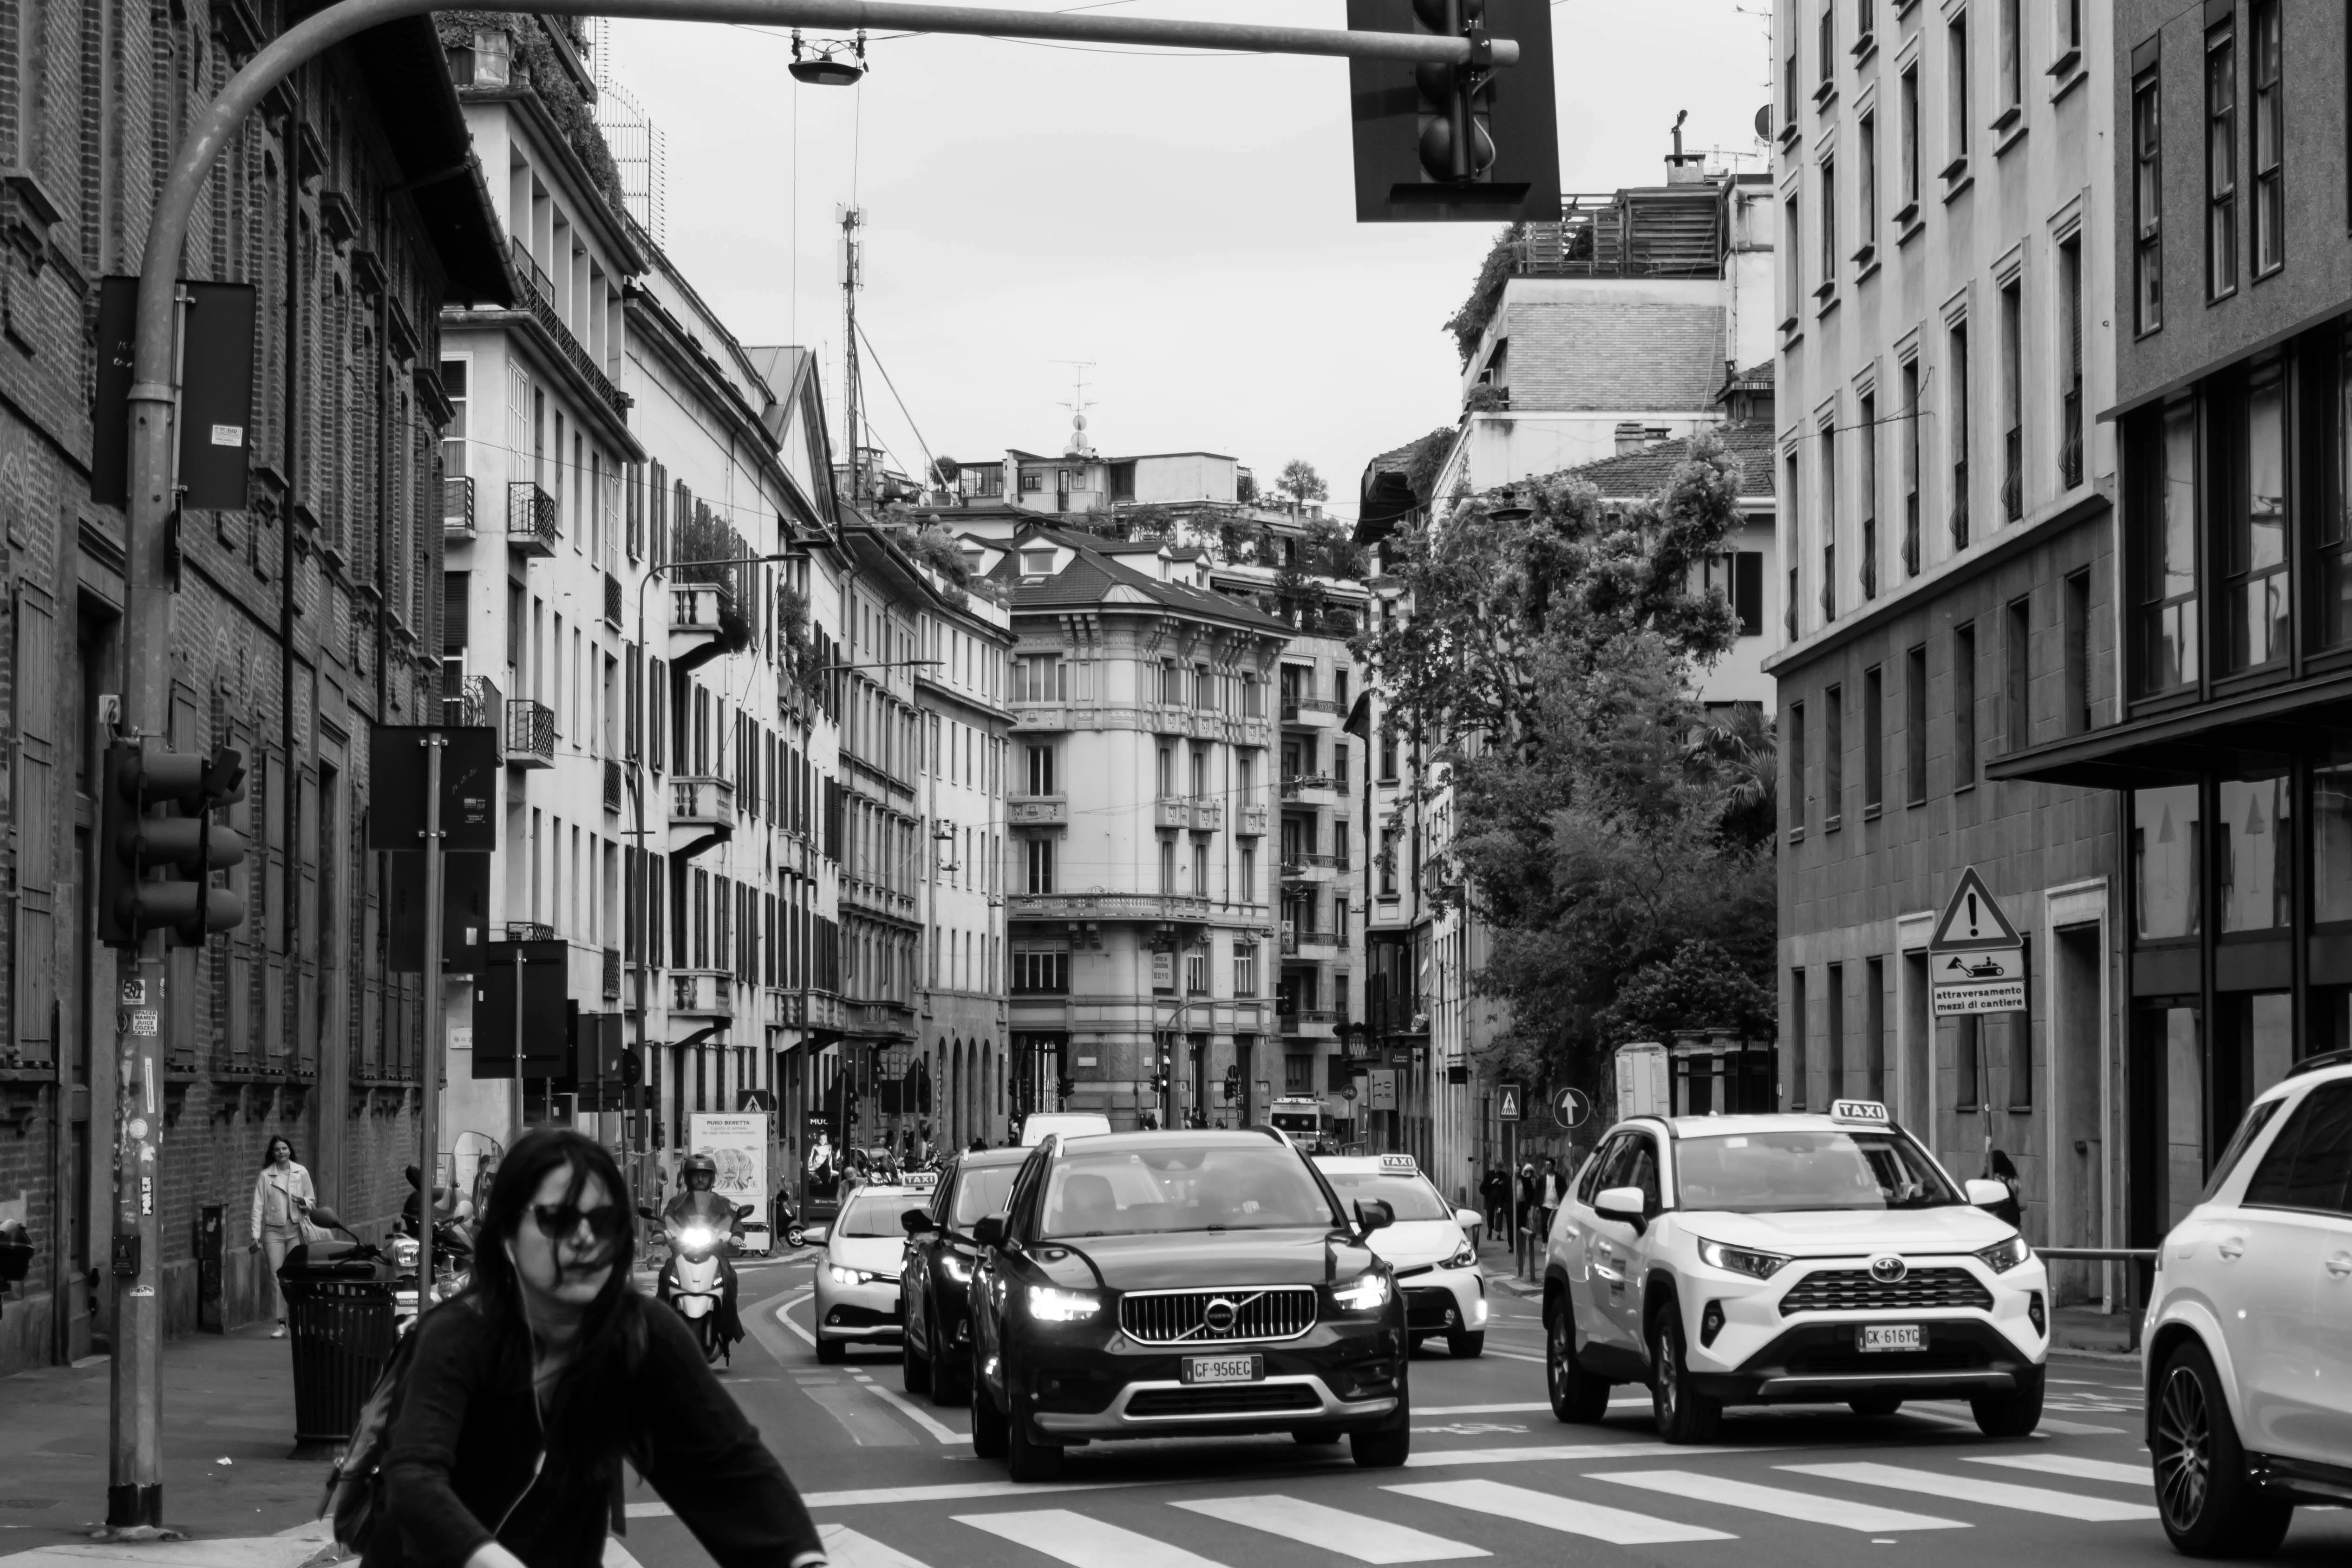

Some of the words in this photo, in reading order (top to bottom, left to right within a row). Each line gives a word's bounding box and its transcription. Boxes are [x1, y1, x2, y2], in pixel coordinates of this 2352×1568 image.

[1936, 987, 2022, 1000] attraversamento
[1937, 1001, 1965, 1011] mezzi
[1968, 1000, 1977, 1009] di
[1980, 999, 2023, 1008] cantiere
[1839, 1104, 1882, 1117] TAXI
